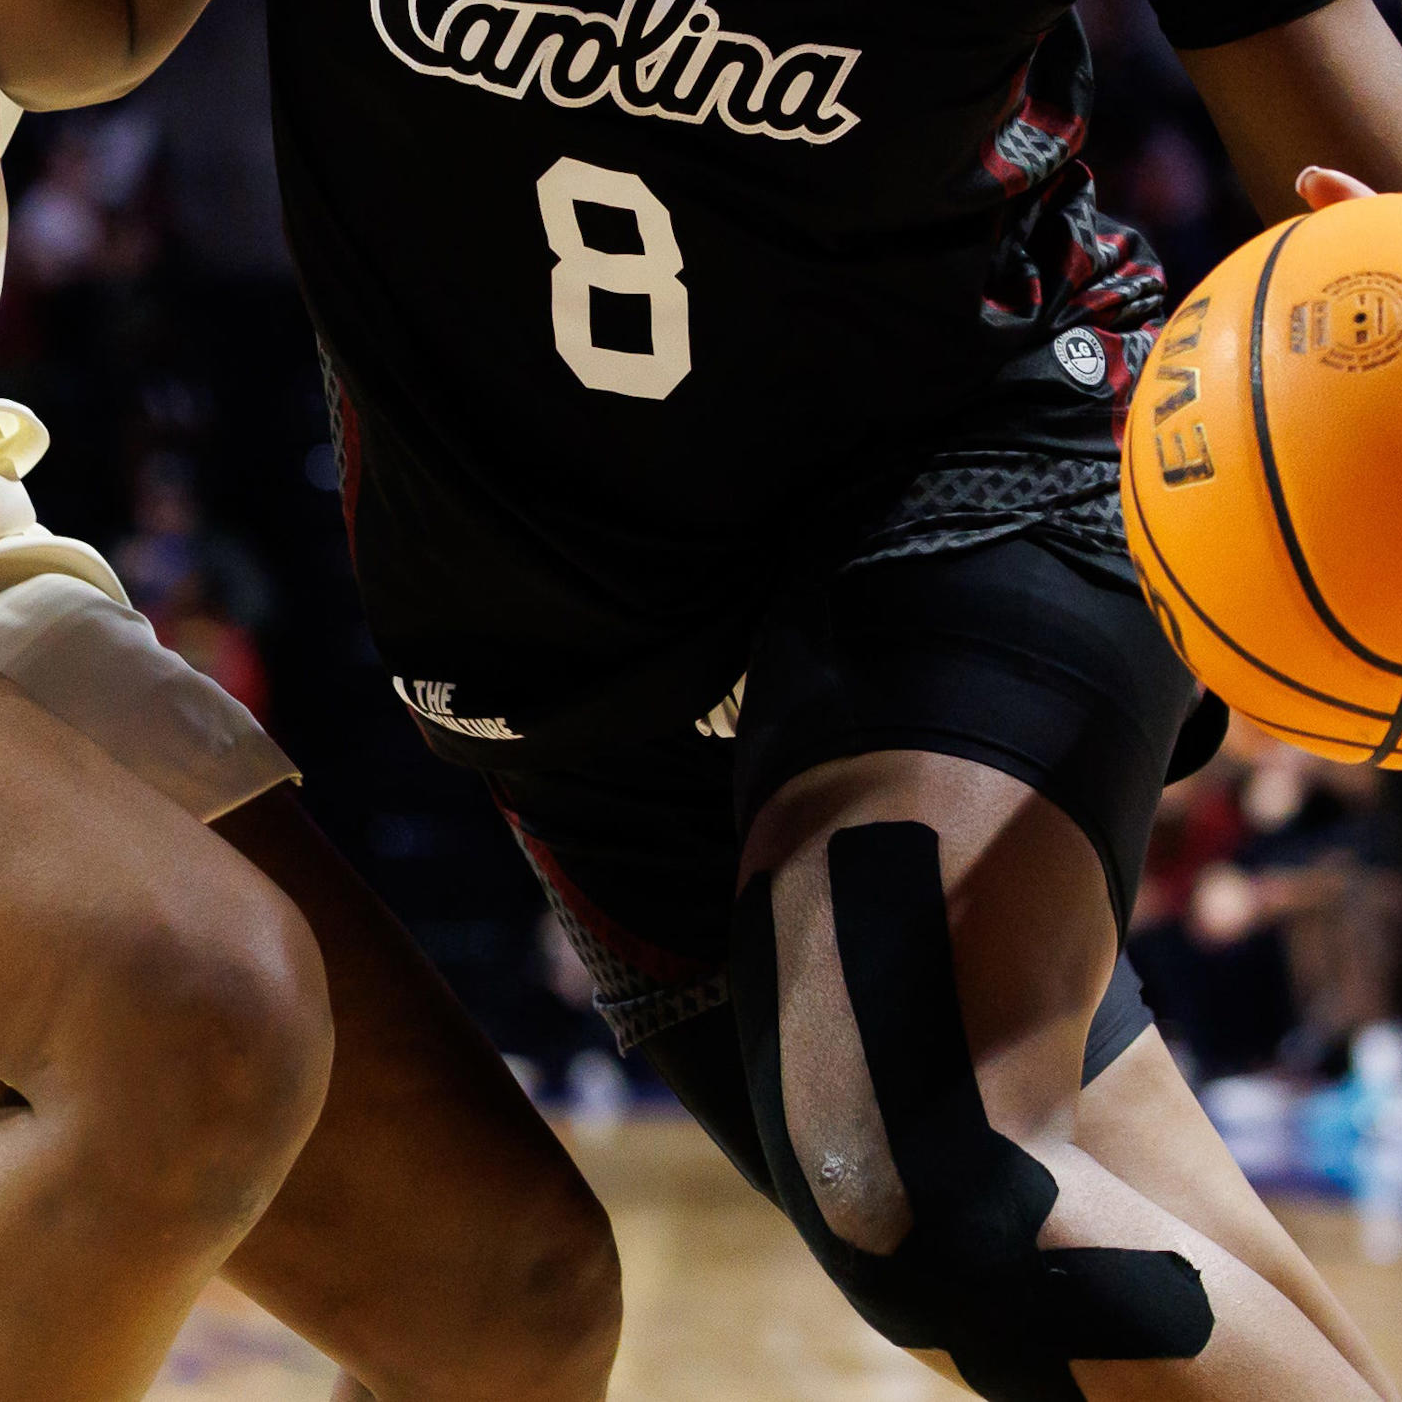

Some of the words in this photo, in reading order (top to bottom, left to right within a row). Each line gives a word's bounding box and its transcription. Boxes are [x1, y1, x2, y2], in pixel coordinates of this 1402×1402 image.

[536, 156, 691, 399] 8
[1068, 342, 1092, 358] LG
[413, 680, 457, 715] THE
